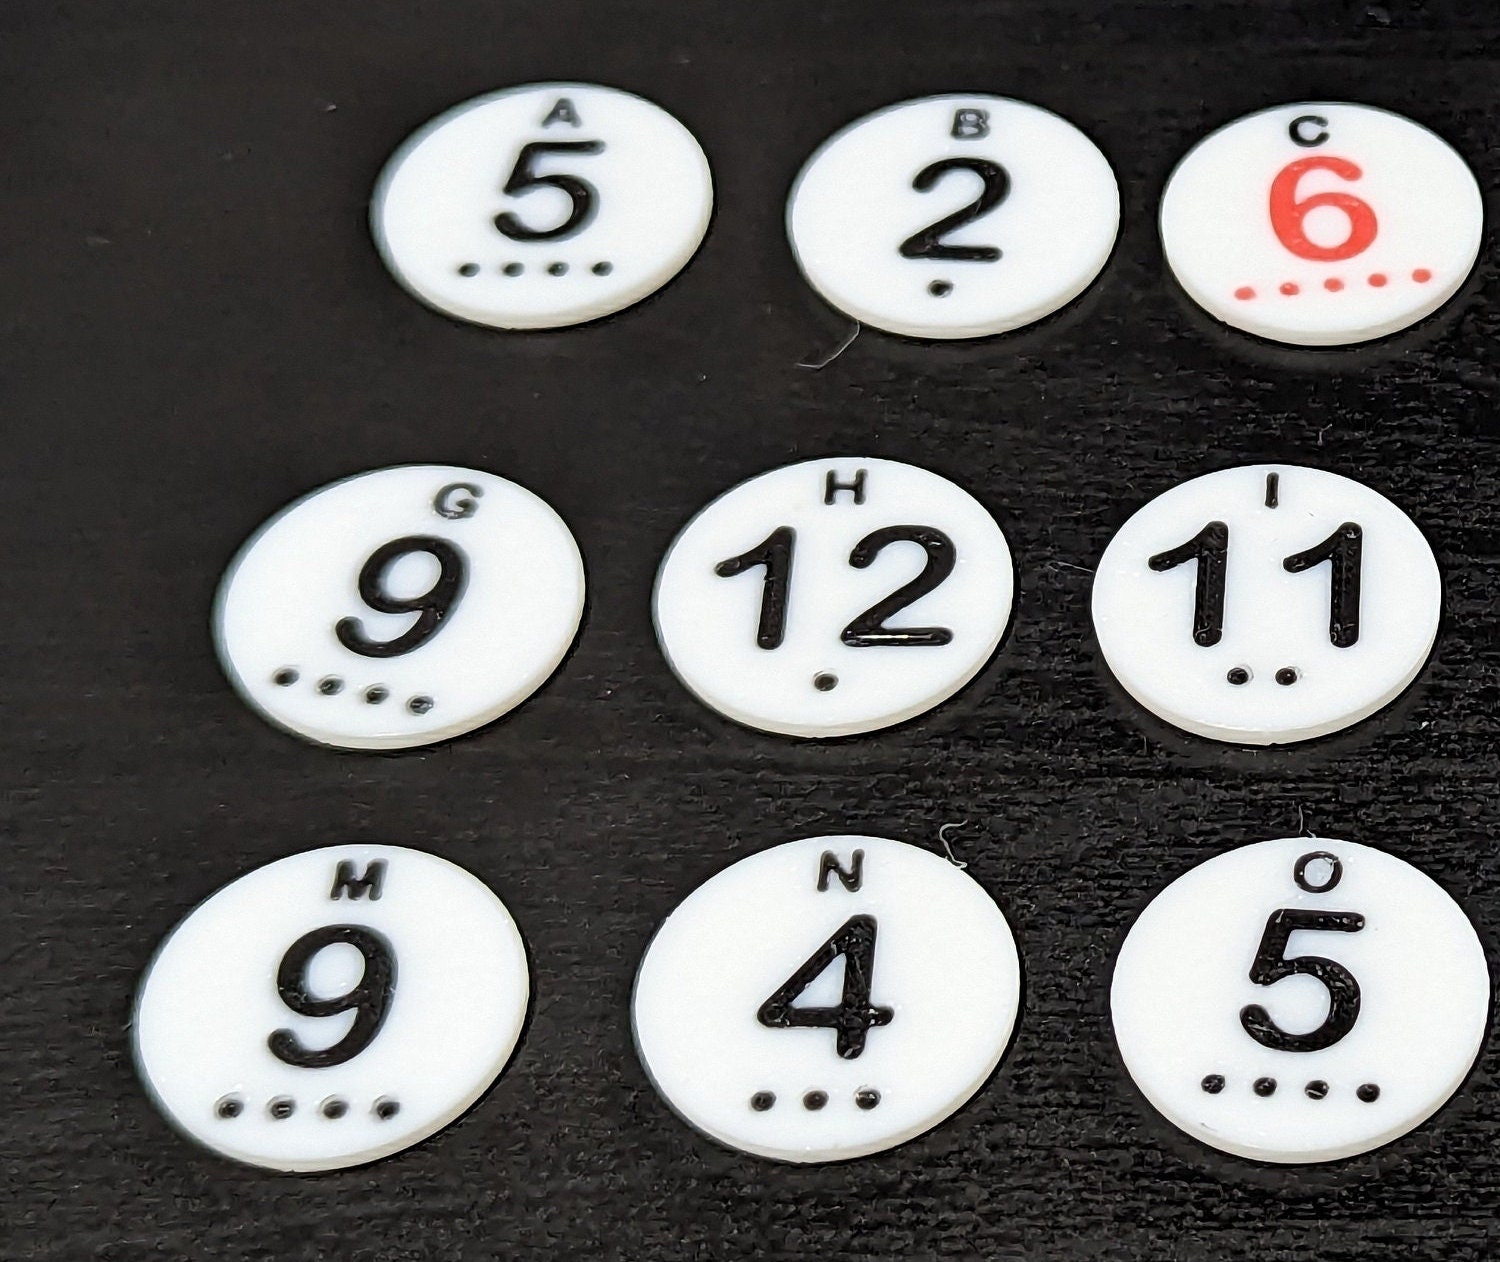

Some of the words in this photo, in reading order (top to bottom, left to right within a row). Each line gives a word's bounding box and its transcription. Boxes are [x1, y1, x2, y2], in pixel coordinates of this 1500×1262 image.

[540, 97, 580, 128] A
[949, 108, 991, 140] B
[1288, 115, 1330, 148] C
[492, 139, 605, 244] 5
[897, 156, 1012, 263] 2
[1269, 155, 1378, 262] 6
[432, 482, 482, 520] G
[823, 468, 868, 506] H
[1264, 472, 1280, 510] I
[334, 534, 470, 659] 9
[714, 524, 957, 651] 12
[1147, 520, 1363, 649] 11
[329, 860, 386, 902] M
[816, 849, 865, 893] N
[1293, 850, 1344, 894] O
[266, 923, 399, 1070] 9
[756, 913, 895, 1061] 4
[1239, 908, 1366, 1054] 5
